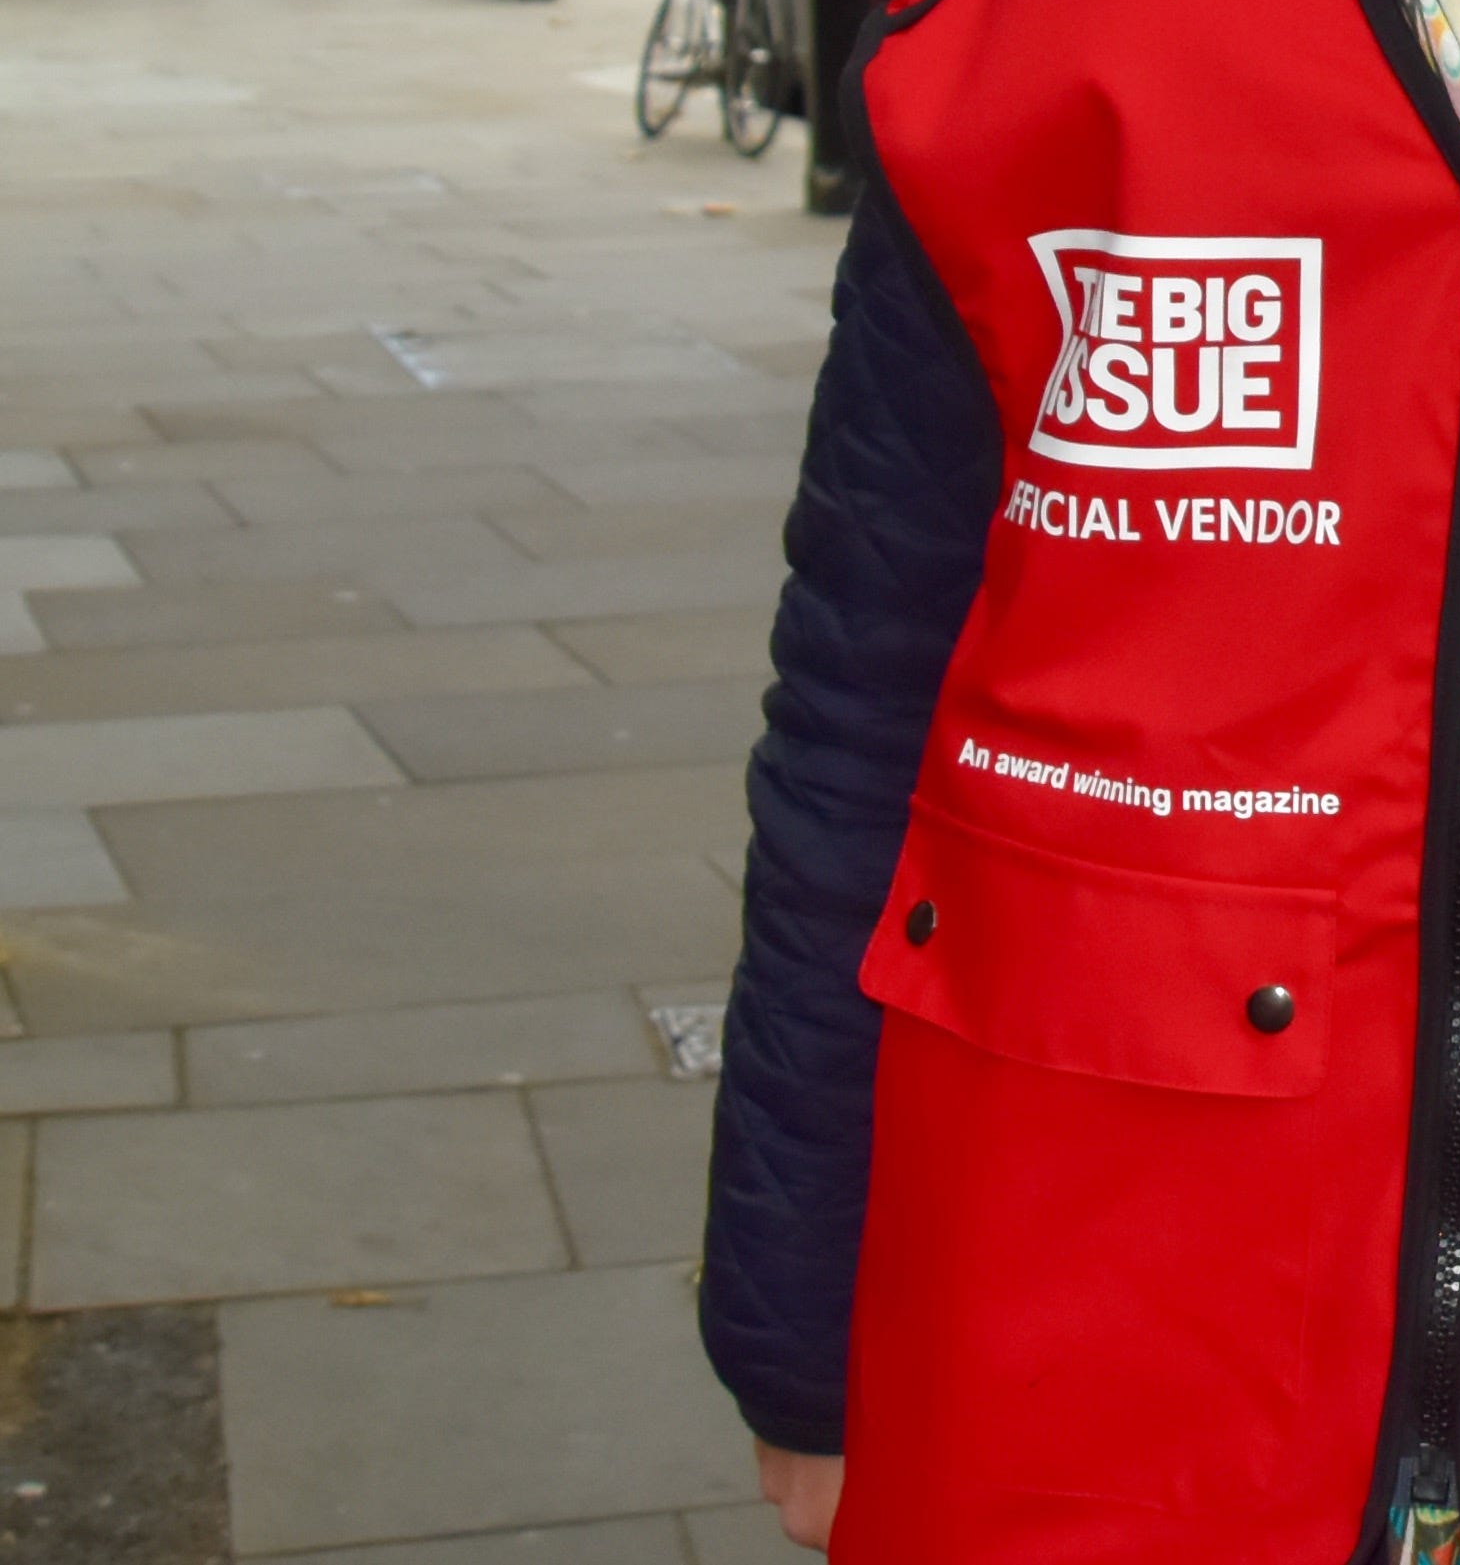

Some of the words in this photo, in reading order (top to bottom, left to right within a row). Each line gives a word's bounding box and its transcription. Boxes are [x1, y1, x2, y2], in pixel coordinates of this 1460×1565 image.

[1152, 275, 1281, 342] BIG
[1046, 335, 1281, 431] ISSUE
[1004, 479, 1141, 541] FFICIAL
[1155, 499, 1341, 545] VENDOR
[958, 738, 990, 770] An
[995, 752, 1069, 790] award
[1074, 770, 1171, 816] winning
[1182, 786, 1340, 819] magazine
